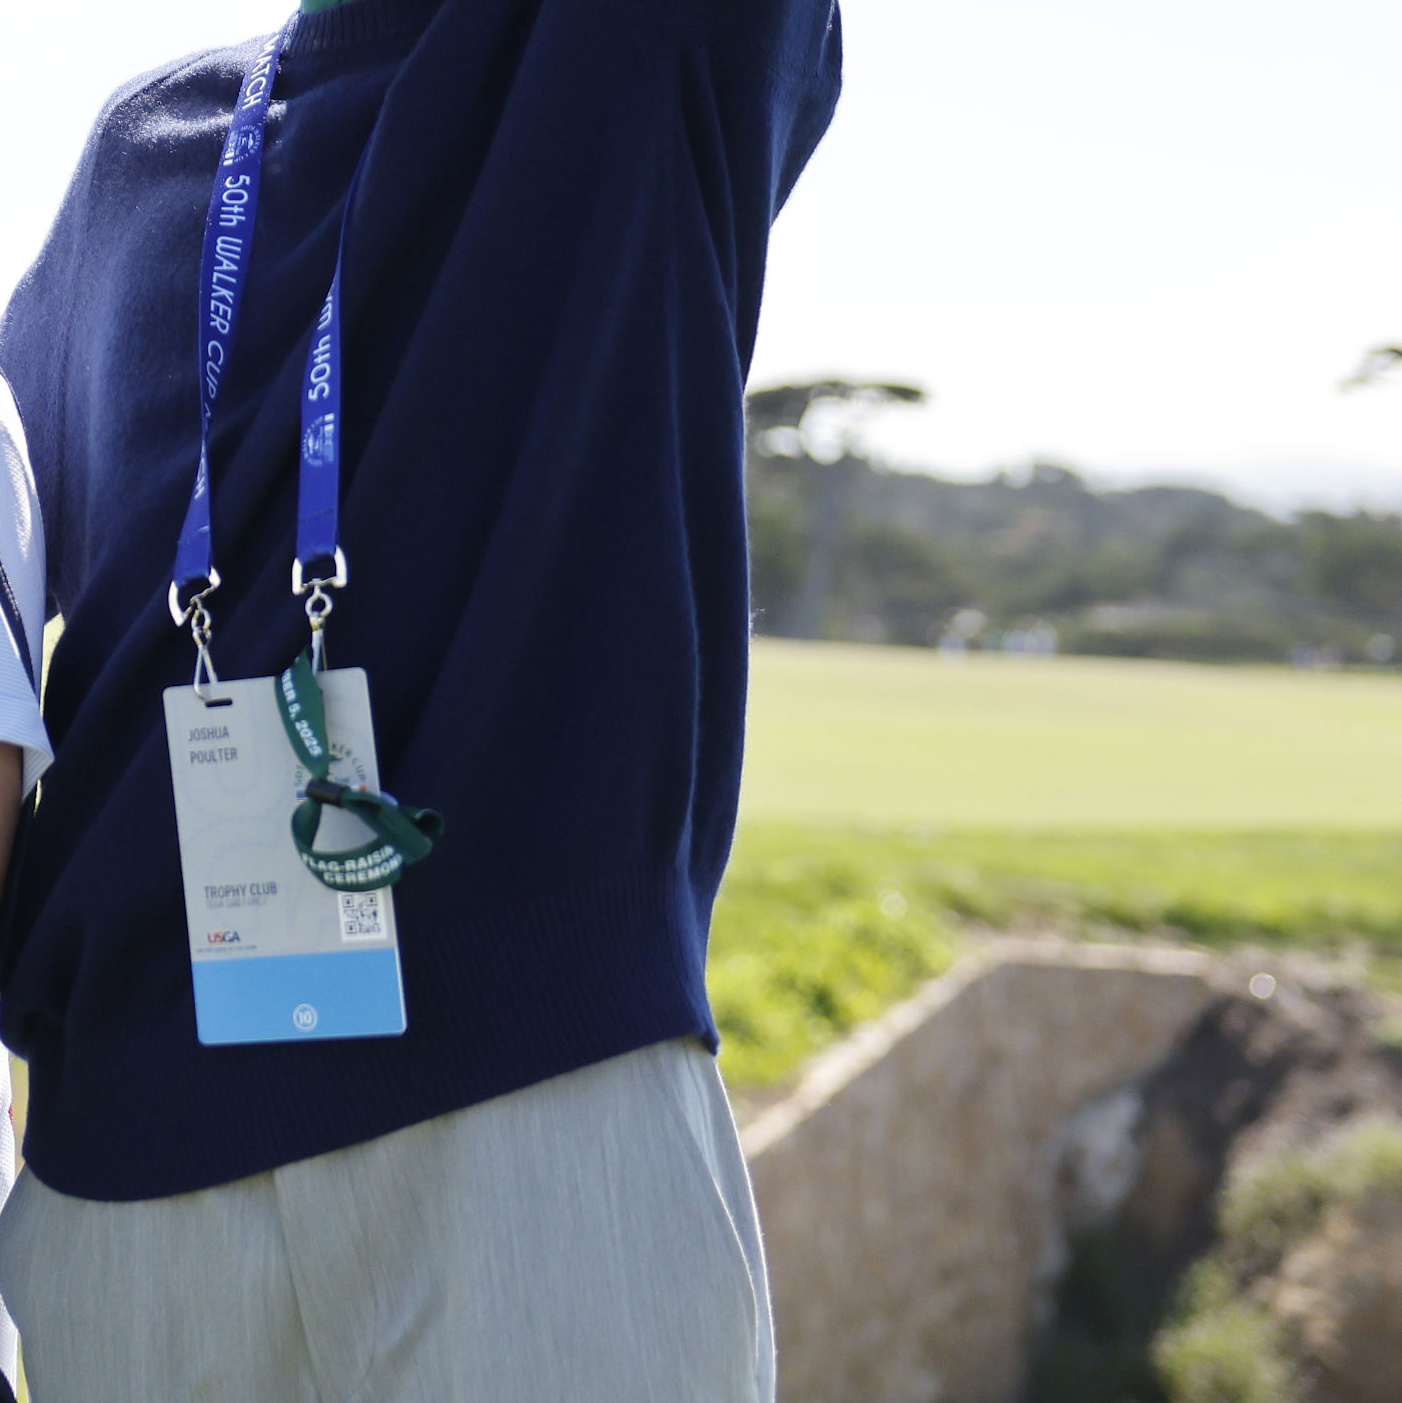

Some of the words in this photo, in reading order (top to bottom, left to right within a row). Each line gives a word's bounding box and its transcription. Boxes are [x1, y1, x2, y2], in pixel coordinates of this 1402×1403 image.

[218, 174, 251, 226] 50th
[209, 235, 243, 335] WALKER
[205, 340, 224, 399] CUP
[308, 334, 331, 401] 50th
[188, 726, 229, 742] JOSHUA
[189, 747, 238, 764] POULTER
[204, 884, 246, 899] TROPHY
[250, 881, 277, 895] CLUB
[207, 930, 240, 943] USGA
